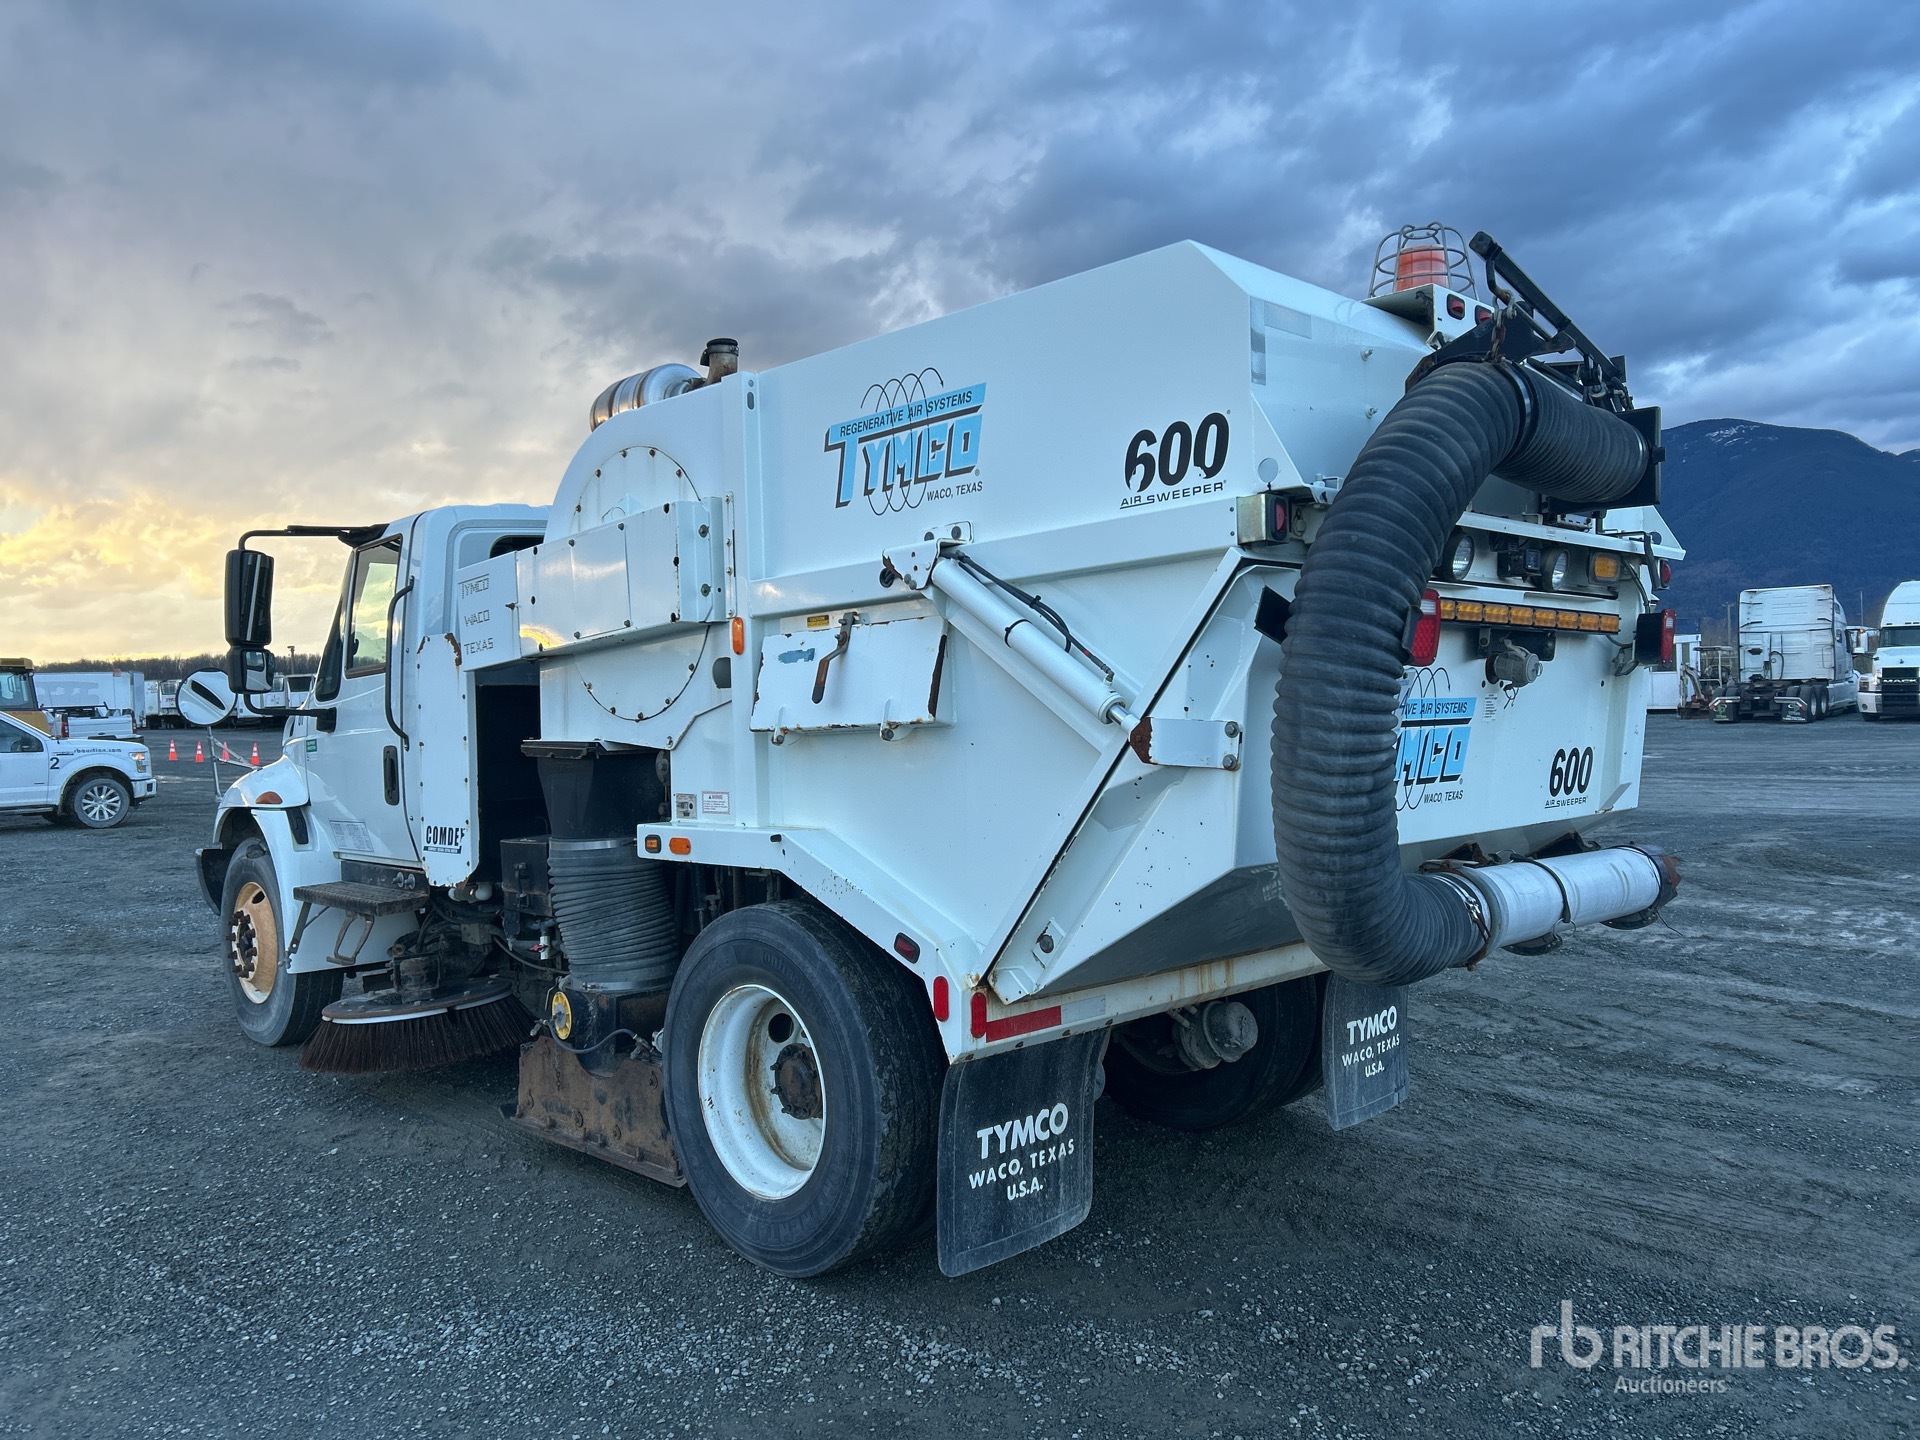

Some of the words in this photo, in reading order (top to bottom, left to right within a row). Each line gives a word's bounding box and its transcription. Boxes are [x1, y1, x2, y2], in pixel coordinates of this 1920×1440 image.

[840, 410, 904, 437] REGENERATIVE
[908, 404, 923, 419] AIR
[927, 391, 973, 413] SYSTEMS
[824, 412, 983, 508] TYMCO
[1124, 412, 1230, 493] 600
[927, 487, 953, 501] WACO,
[955, 481, 983, 496] TEXAS
[1120, 496, 1143, 508] AIR
[1146, 483, 1225, 503] SWEEPER
[458, 573, 490, 600] TYMCO
[464, 610, 490, 627] WACO
[464, 637, 494, 655] TEXAS
[1420, 703, 1433, 715] AIR
[1435, 702, 1468, 714] SYSTEMS
[50, 757, 60, 770] 2
[1395, 727, 1472, 787] MCO
[1549, 746, 1594, 797] 600
[1424, 792, 1443, 804] WACO,
[1445, 790, 1463, 802] TEXAS
[1545, 800, 1556, 809] AIR
[1557, 797, 1587, 808] SWEEPER
[1346, 1005, 1398, 1046] TYMCO
[1342, 1047, 1375, 1067] WACO,
[1377, 1034, 1400, 1057] TEXAS
[1365, 1060, 1385, 1078] U.S.A.
[976, 1102, 1069, 1160] TYMCO
[968, 1158, 1024, 1190] WACO,
[1030, 1138, 1075, 1170] TEXAS
[1006, 1177, 1044, 1201] U.S.A.
